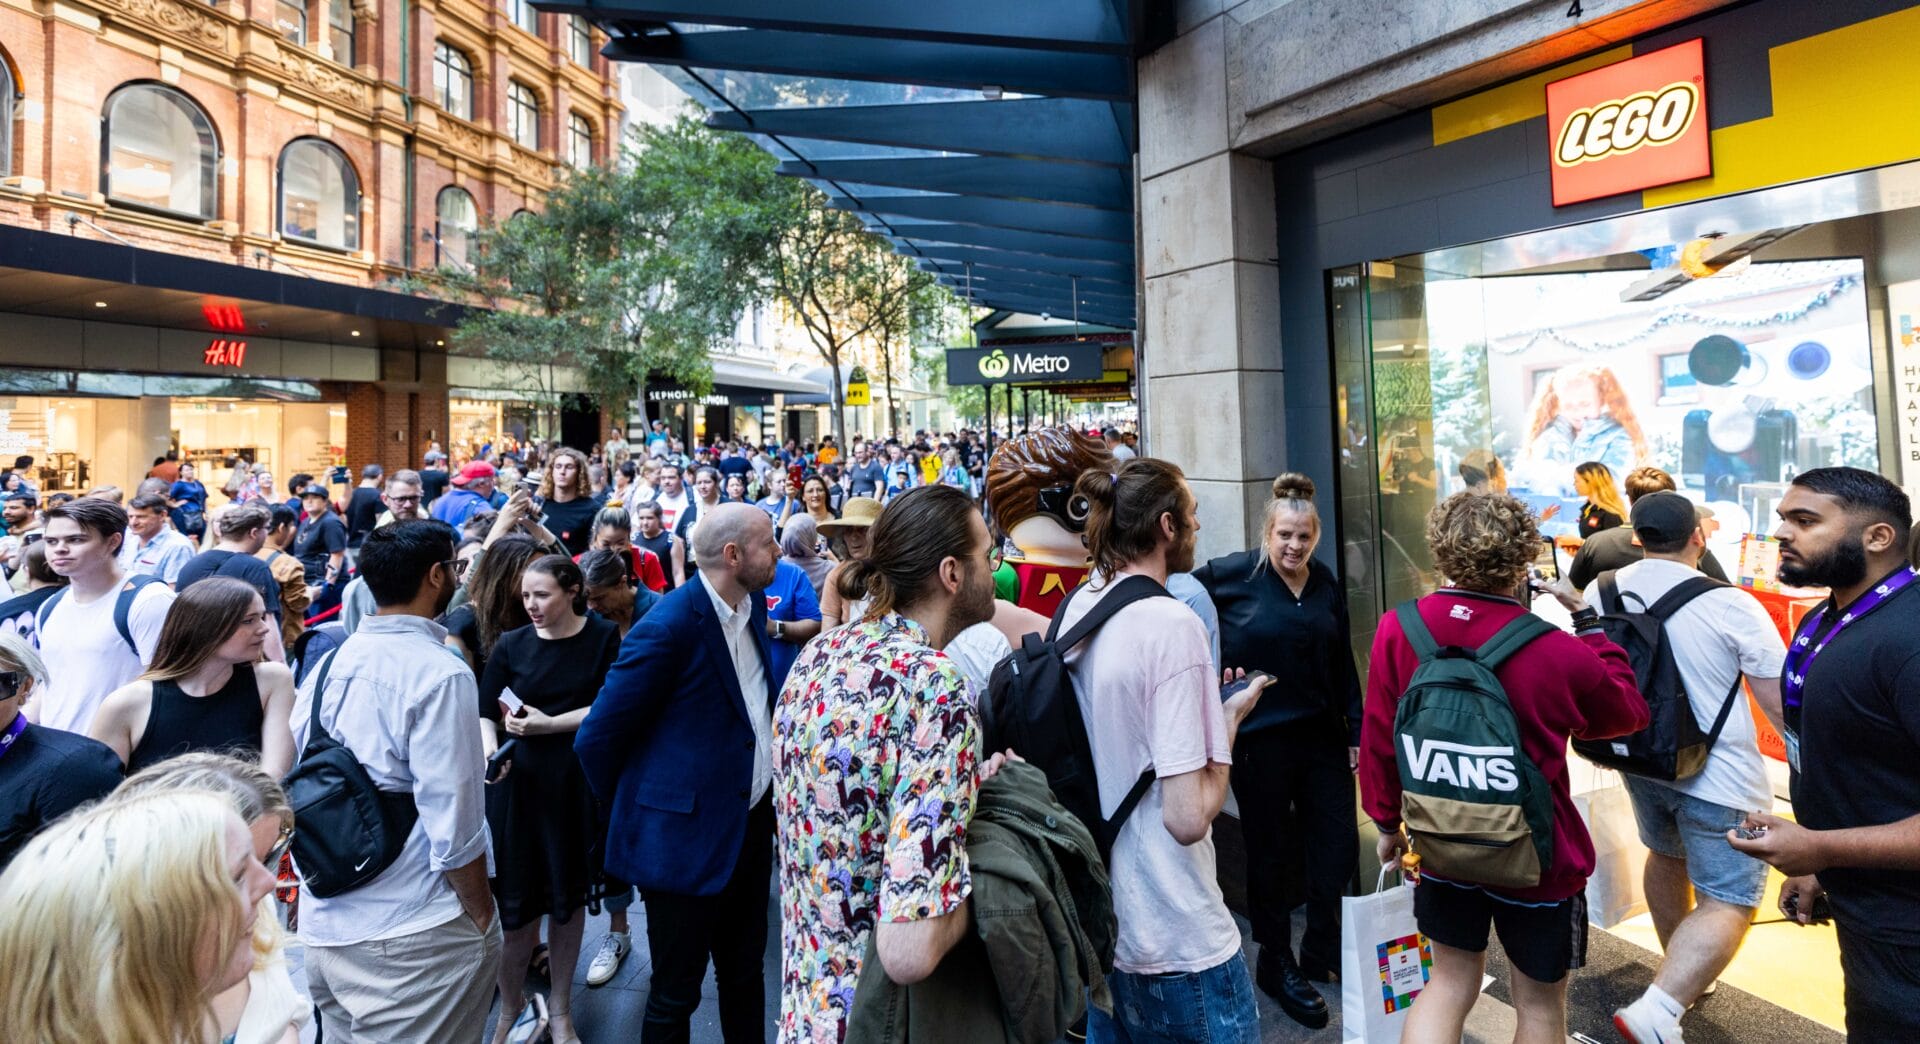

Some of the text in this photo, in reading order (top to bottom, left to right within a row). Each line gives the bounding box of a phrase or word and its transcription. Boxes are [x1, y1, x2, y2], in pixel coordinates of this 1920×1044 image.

[1567, 0, 1583, 17] 4
[1555, 82, 1699, 167] LEGO
[205, 340, 246, 367] H&M
[1013, 353, 1070, 374] Metro
[649, 390, 696, 401] SEPHORA
[1401, 733, 1519, 791] VANS
